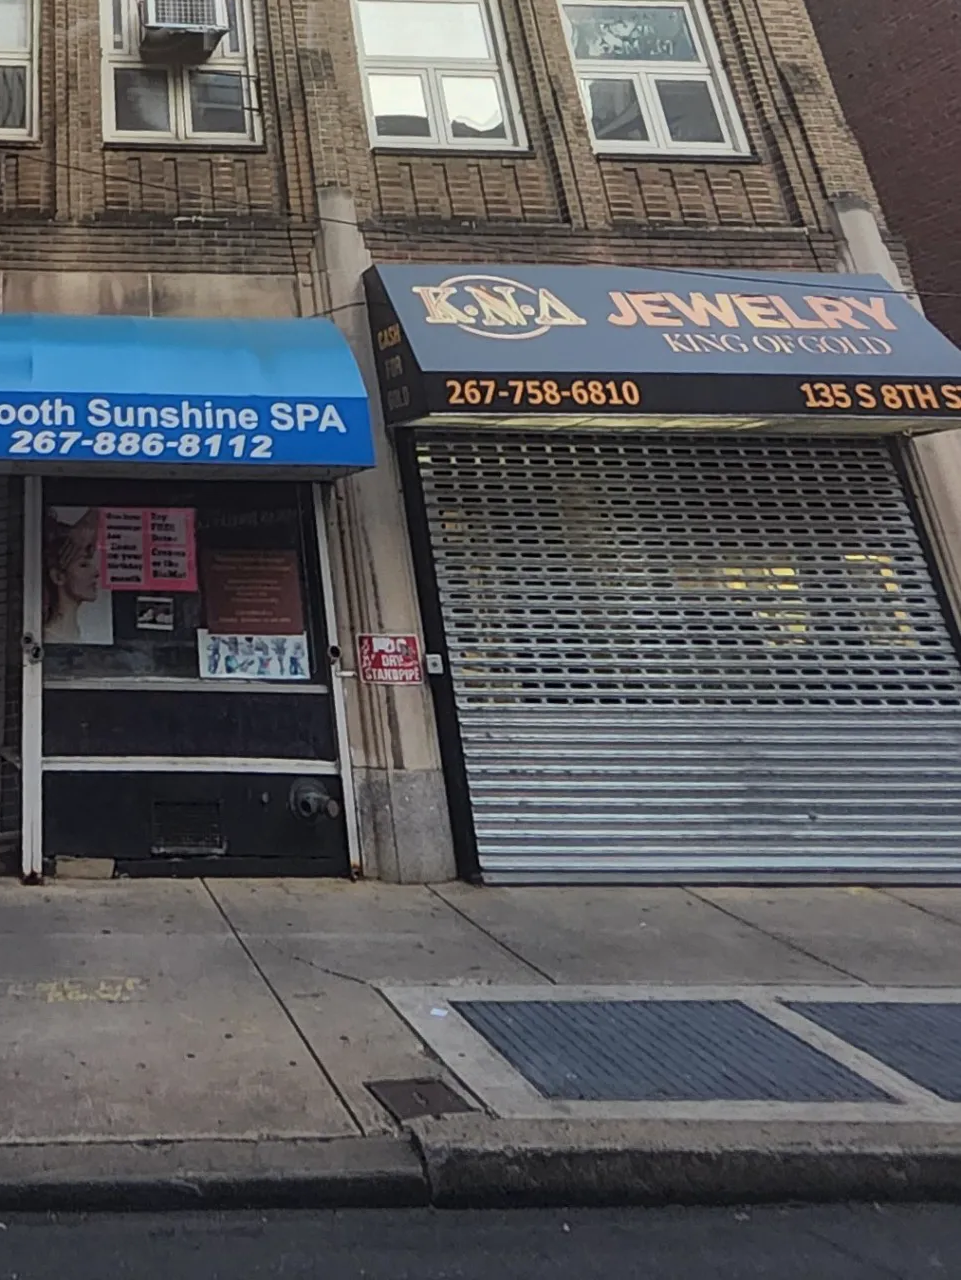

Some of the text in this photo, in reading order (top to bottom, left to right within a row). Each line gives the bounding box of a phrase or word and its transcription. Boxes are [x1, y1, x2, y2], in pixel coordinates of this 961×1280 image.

[607, 291, 898, 331] JEWELRY
[662, 333, 892, 356] KING OF GOLD
[445, 380, 640, 406] 267-758-6810
[800, 382, 852, 409] 135
[854, 383, 877, 409] S
[880, 384, 941, 409] 8TH
[87, 398, 258, 430] Sunshine
[270, 402, 347, 433] SPA
[9, 429, 273, 458] 267-886-8112
